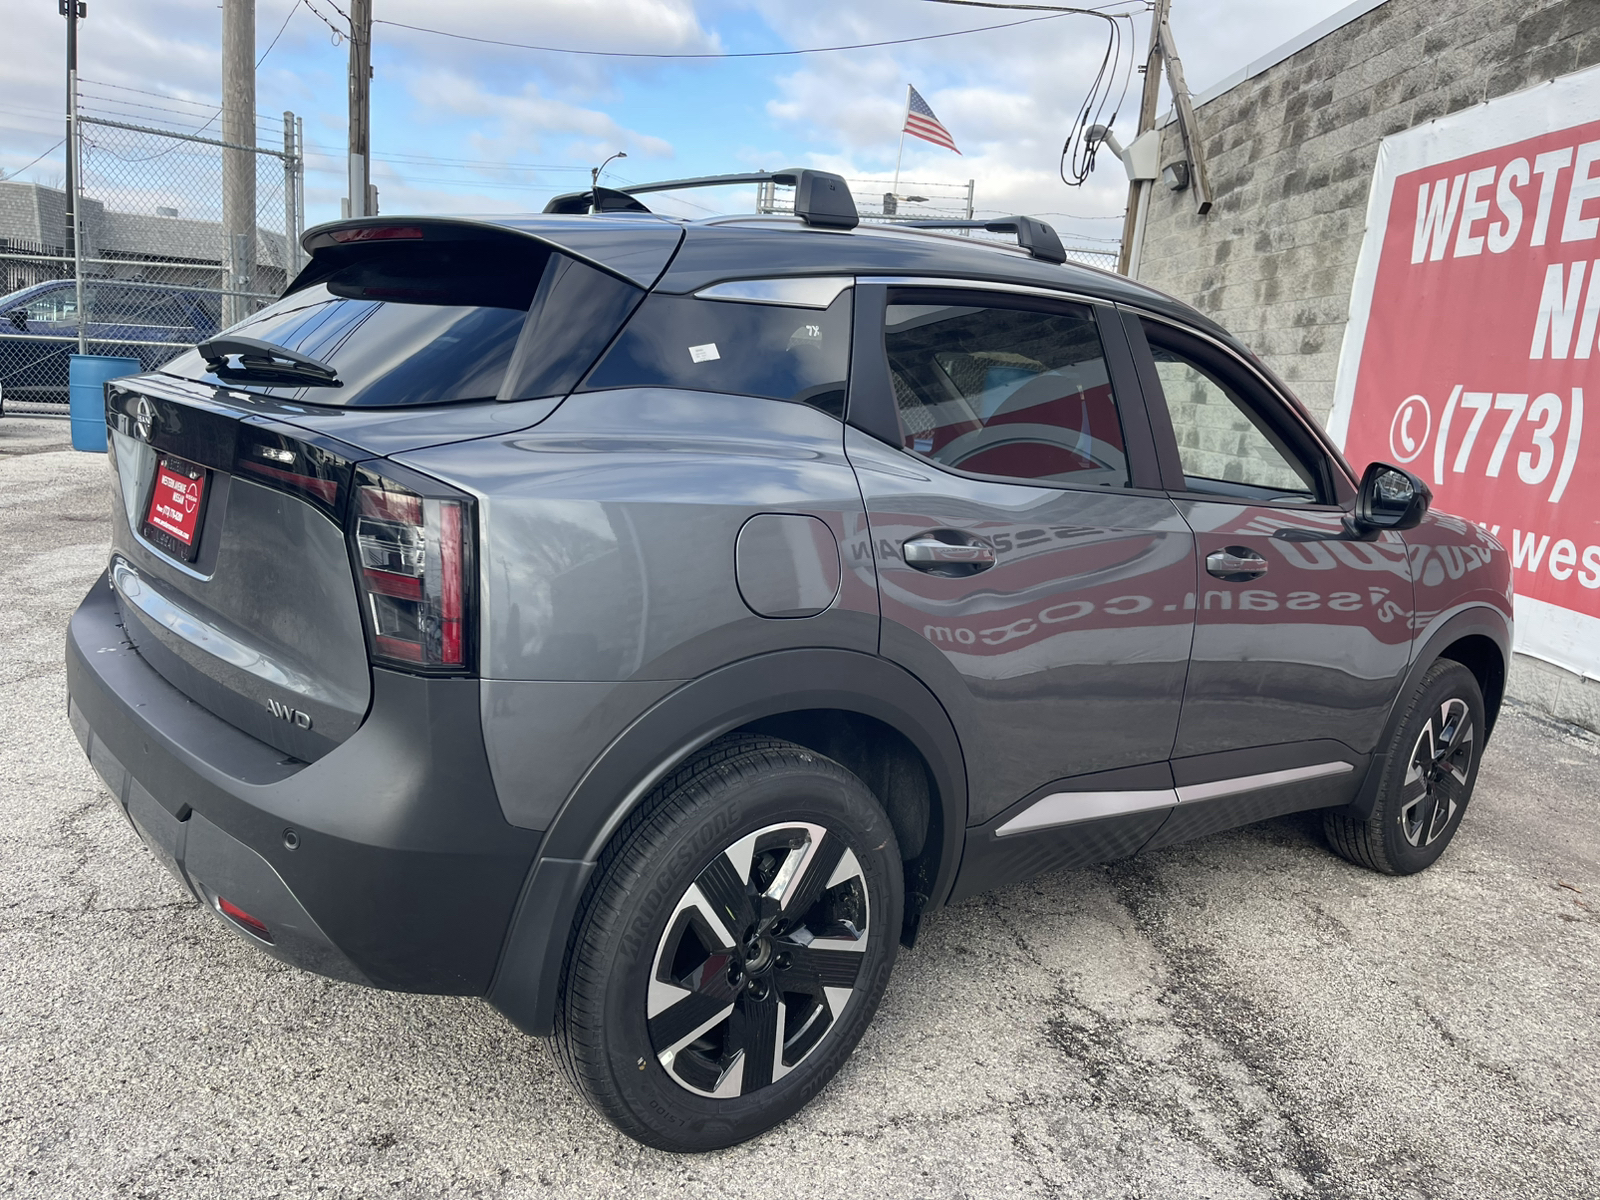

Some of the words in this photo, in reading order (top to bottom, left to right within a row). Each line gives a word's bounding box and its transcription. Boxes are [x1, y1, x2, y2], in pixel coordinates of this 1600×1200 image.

[1411, 139, 1600, 265] WESTE
[1529, 258, 1600, 360] NI
[1433, 384, 1584, 504] (773)
[265, 698, 311, 731] AWD
[620, 801, 742, 961] BRIDGESTONE
